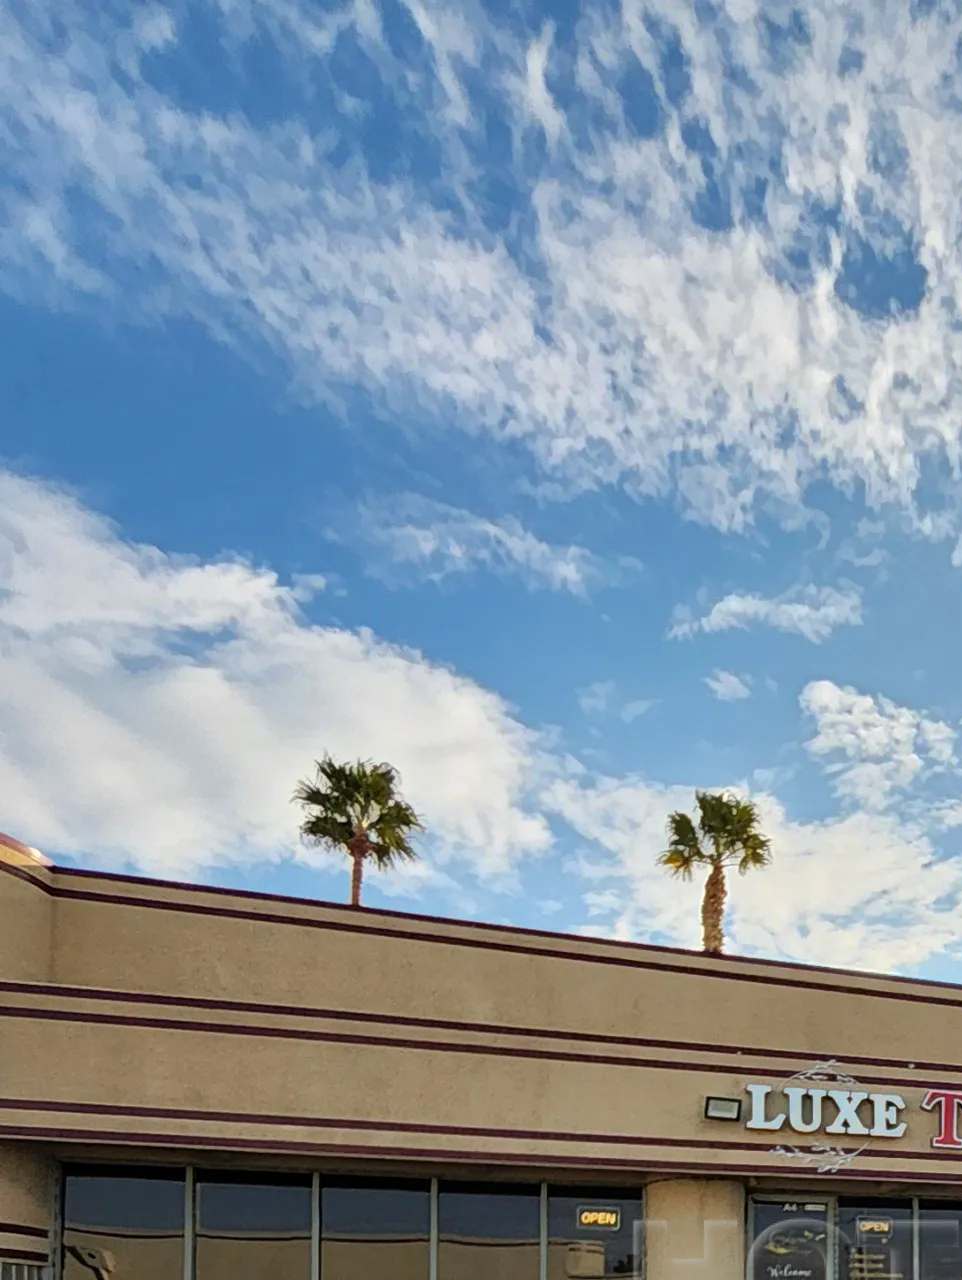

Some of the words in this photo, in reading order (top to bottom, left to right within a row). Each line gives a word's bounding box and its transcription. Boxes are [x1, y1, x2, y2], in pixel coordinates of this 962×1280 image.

[745, 1083, 908, 1138] LUXE
[581, 1211, 617, 1224] OPEN
[860, 1221, 890, 1232] OPEN
[767, 1264, 811, 1277] Welcome
